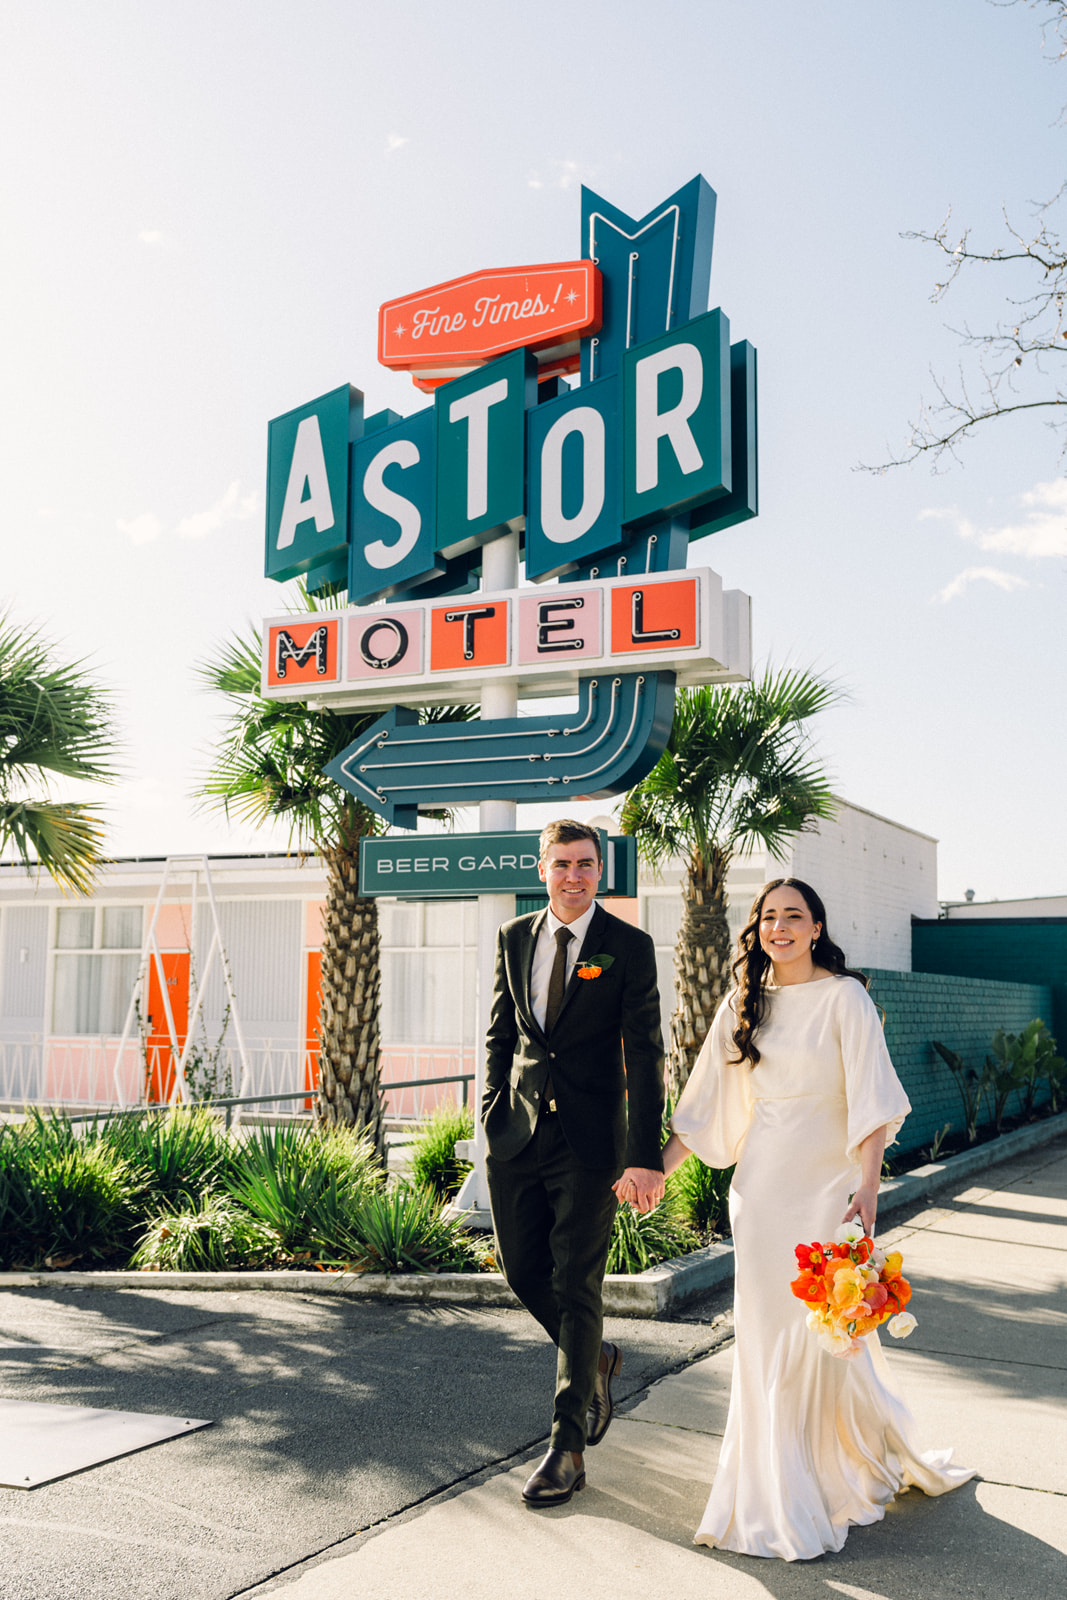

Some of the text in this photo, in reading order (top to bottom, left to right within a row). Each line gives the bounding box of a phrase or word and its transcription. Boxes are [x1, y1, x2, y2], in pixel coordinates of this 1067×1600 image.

[411, 283, 563, 340] Fine Times!
[276, 342, 704, 570] ASTOR
[275, 591, 681, 678] MOTEL
[377, 854, 538, 873] BEER GARD
